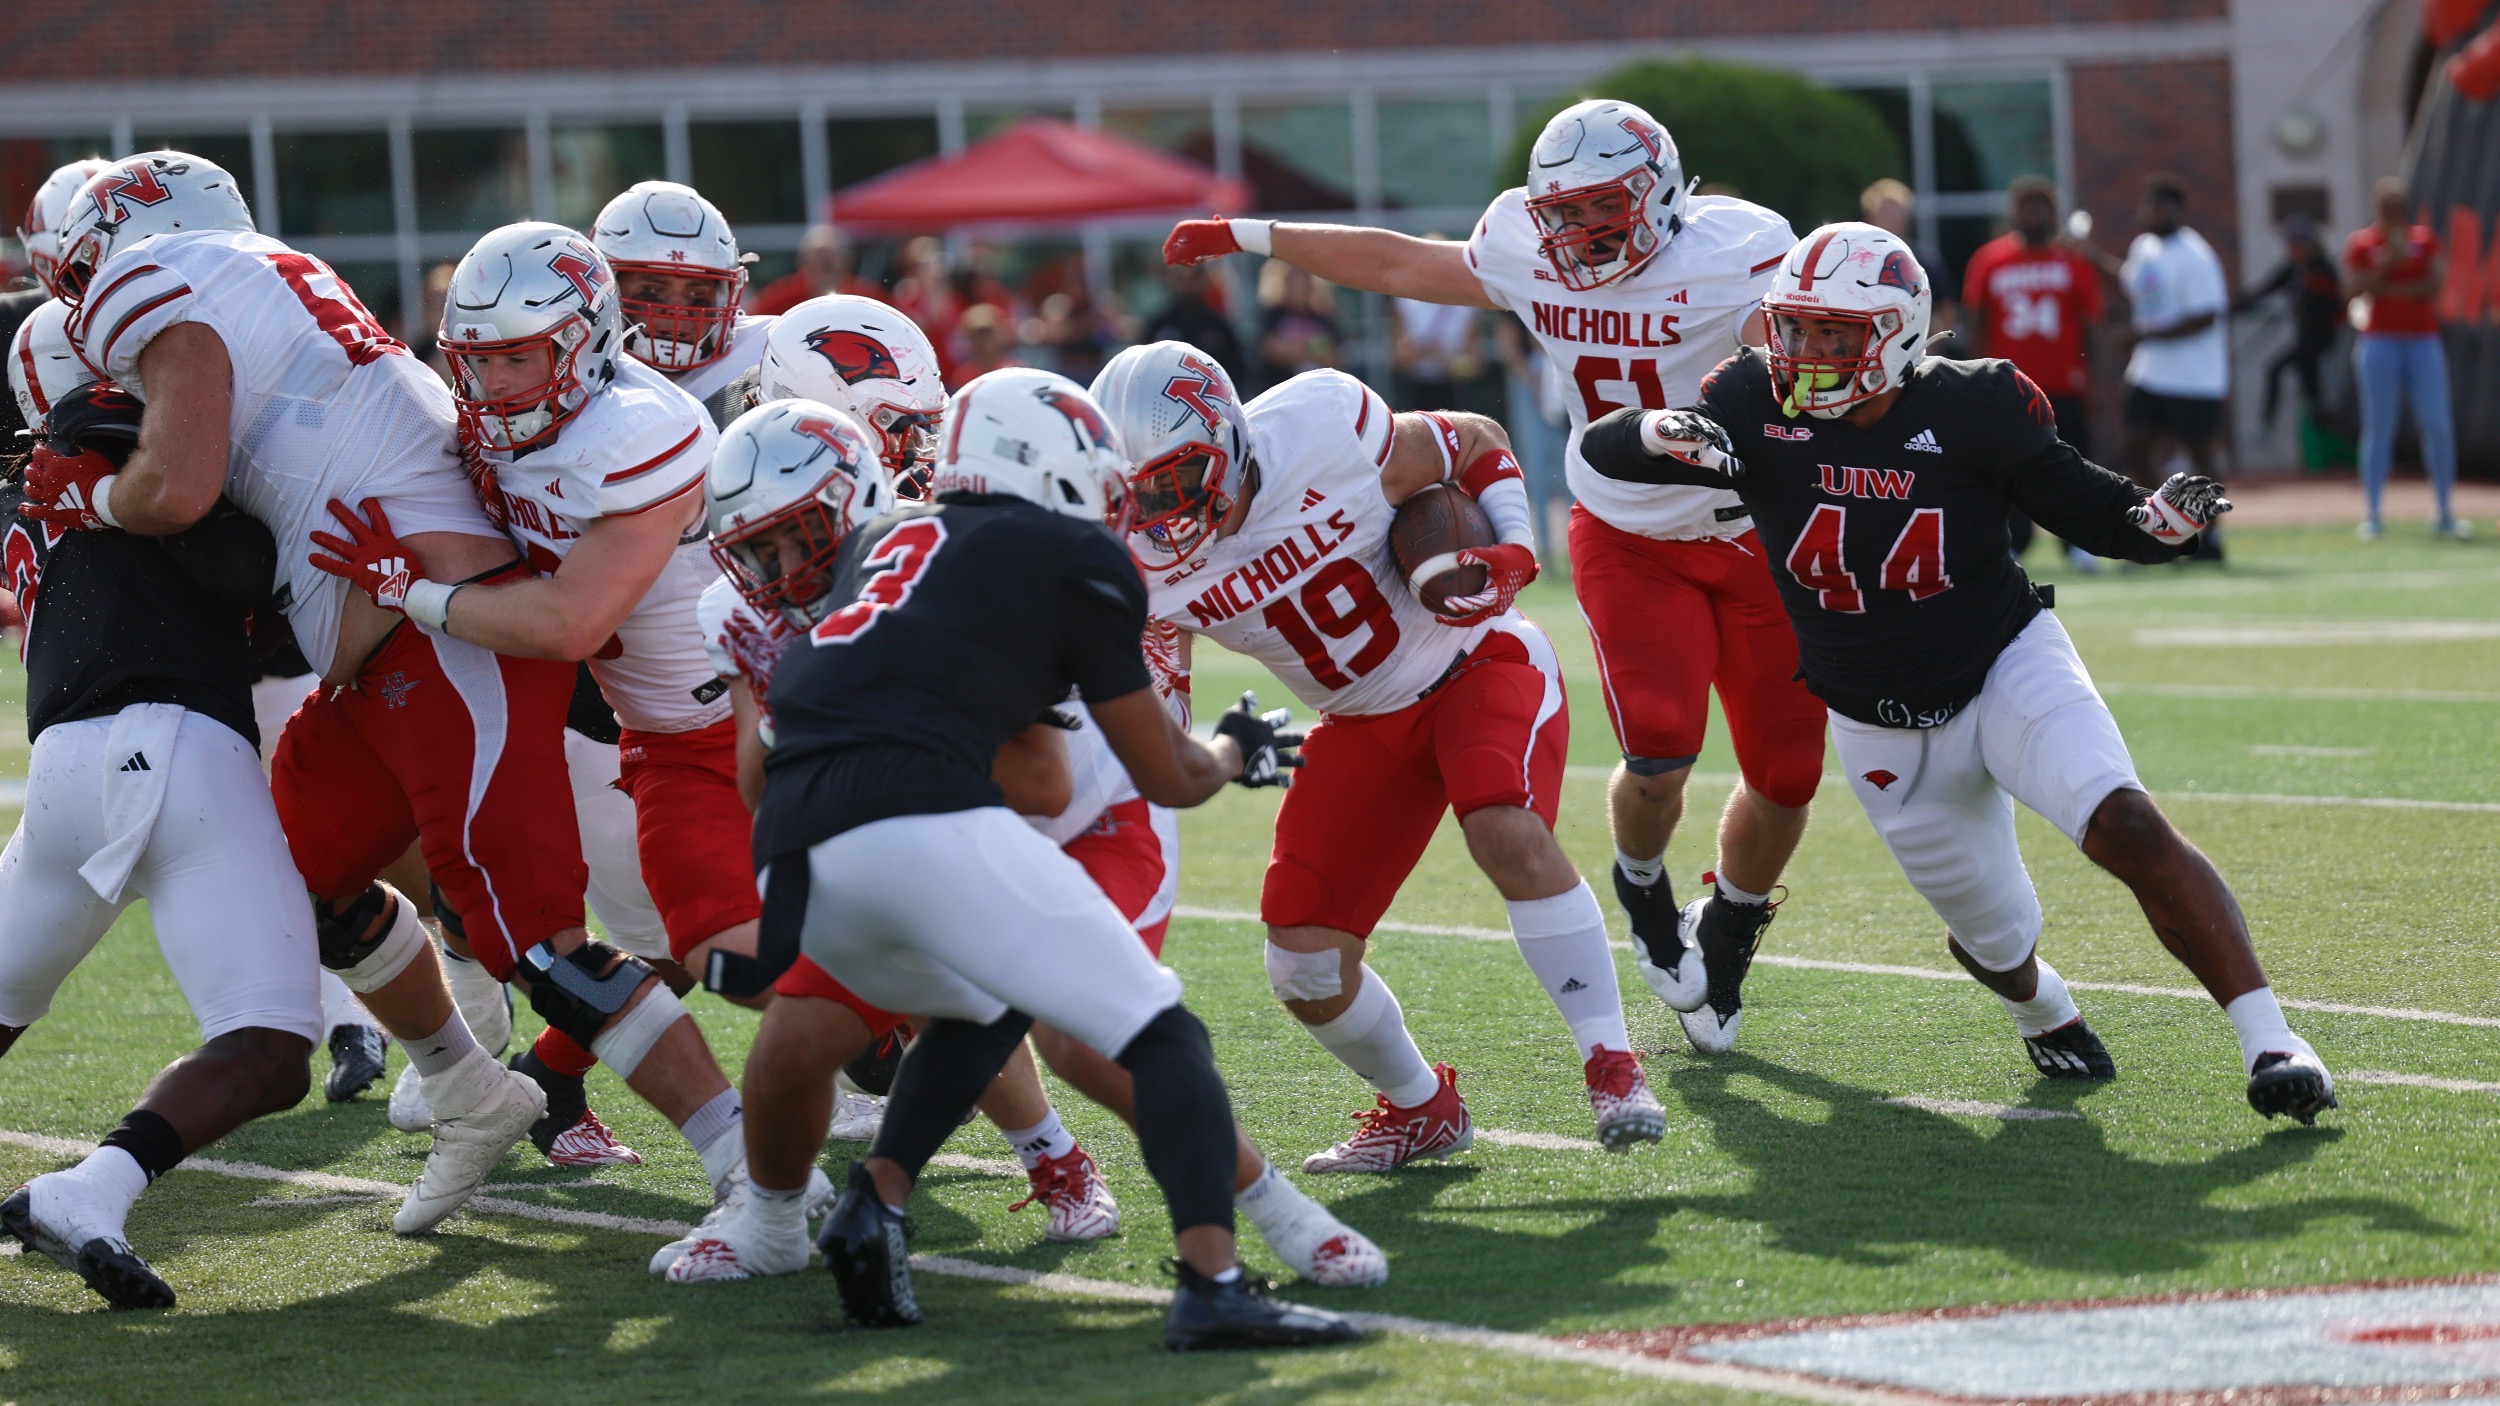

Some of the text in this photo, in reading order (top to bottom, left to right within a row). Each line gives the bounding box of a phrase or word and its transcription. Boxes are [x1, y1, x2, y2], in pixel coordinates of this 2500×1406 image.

[1532, 301, 1681, 348] NICHOLLS
[1786, 293, 1819, 304] Riddell
[1161, 352, 1234, 437] N
[1816, 464, 1916, 500] UIW
[1904, 441, 1943, 454] adidas
[810, 515, 949, 648] 3
[1187, 509, 1355, 628] NICHOLLS
[1786, 502, 1955, 615] 44
[1262, 557, 1400, 691] 19
